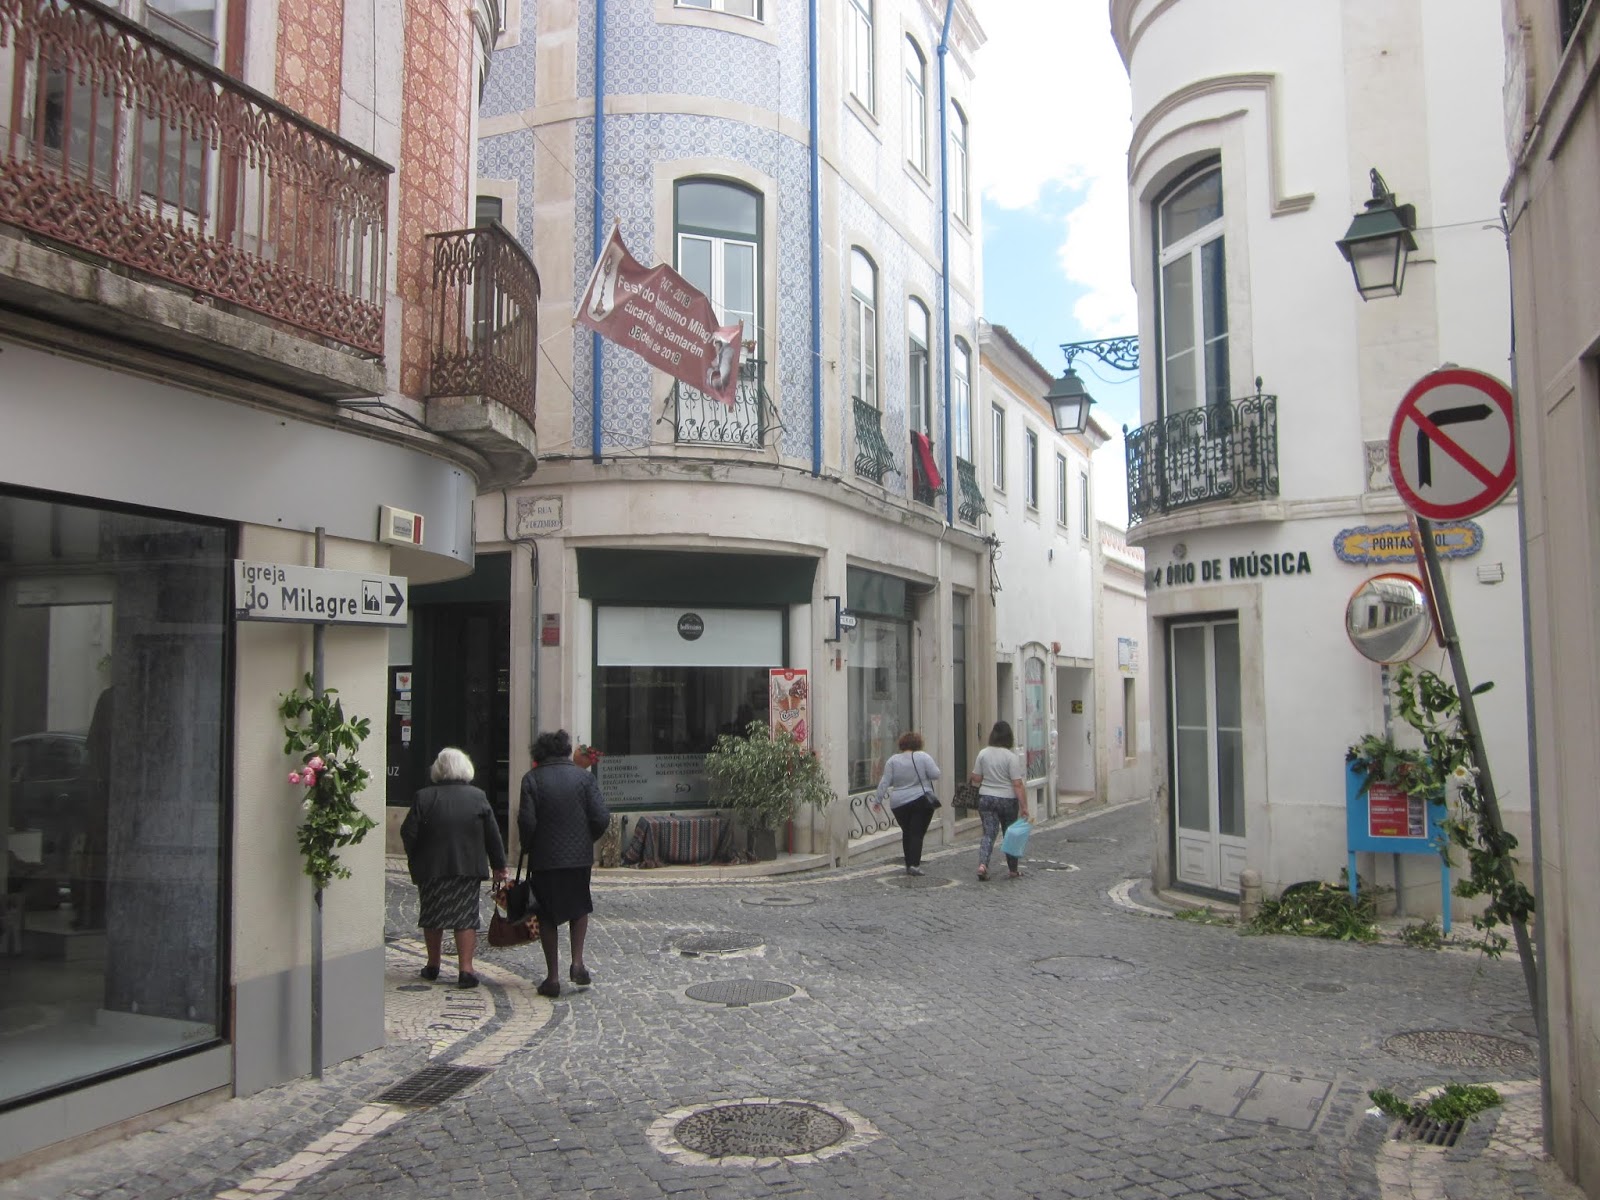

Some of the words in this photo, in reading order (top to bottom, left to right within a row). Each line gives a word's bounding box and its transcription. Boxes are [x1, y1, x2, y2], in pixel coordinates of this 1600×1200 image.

[617, 275, 644, 294] Fest
[642, 287, 655, 303] do
[660, 276, 673, 292] 247
[673, 289, 692, 308] 2018
[655, 321, 665, 335] de
[664, 326, 704, 358] Santarém
[652, 342, 661, 353] de
[660, 347, 682, 365] 2018
[537, 506, 552, 514] RUA
[1372, 535, 1414, 551] PORTAS
[1435, 533, 1448, 547] OL
[242, 562, 286, 585] igreja
[1201, 558, 1222, 581] DE
[1229, 551, 1312, 579] MÚSICA
[245, 585, 269, 609] do
[281, 587, 357, 619] Milagre
[387, 766, 399, 777] UZ
